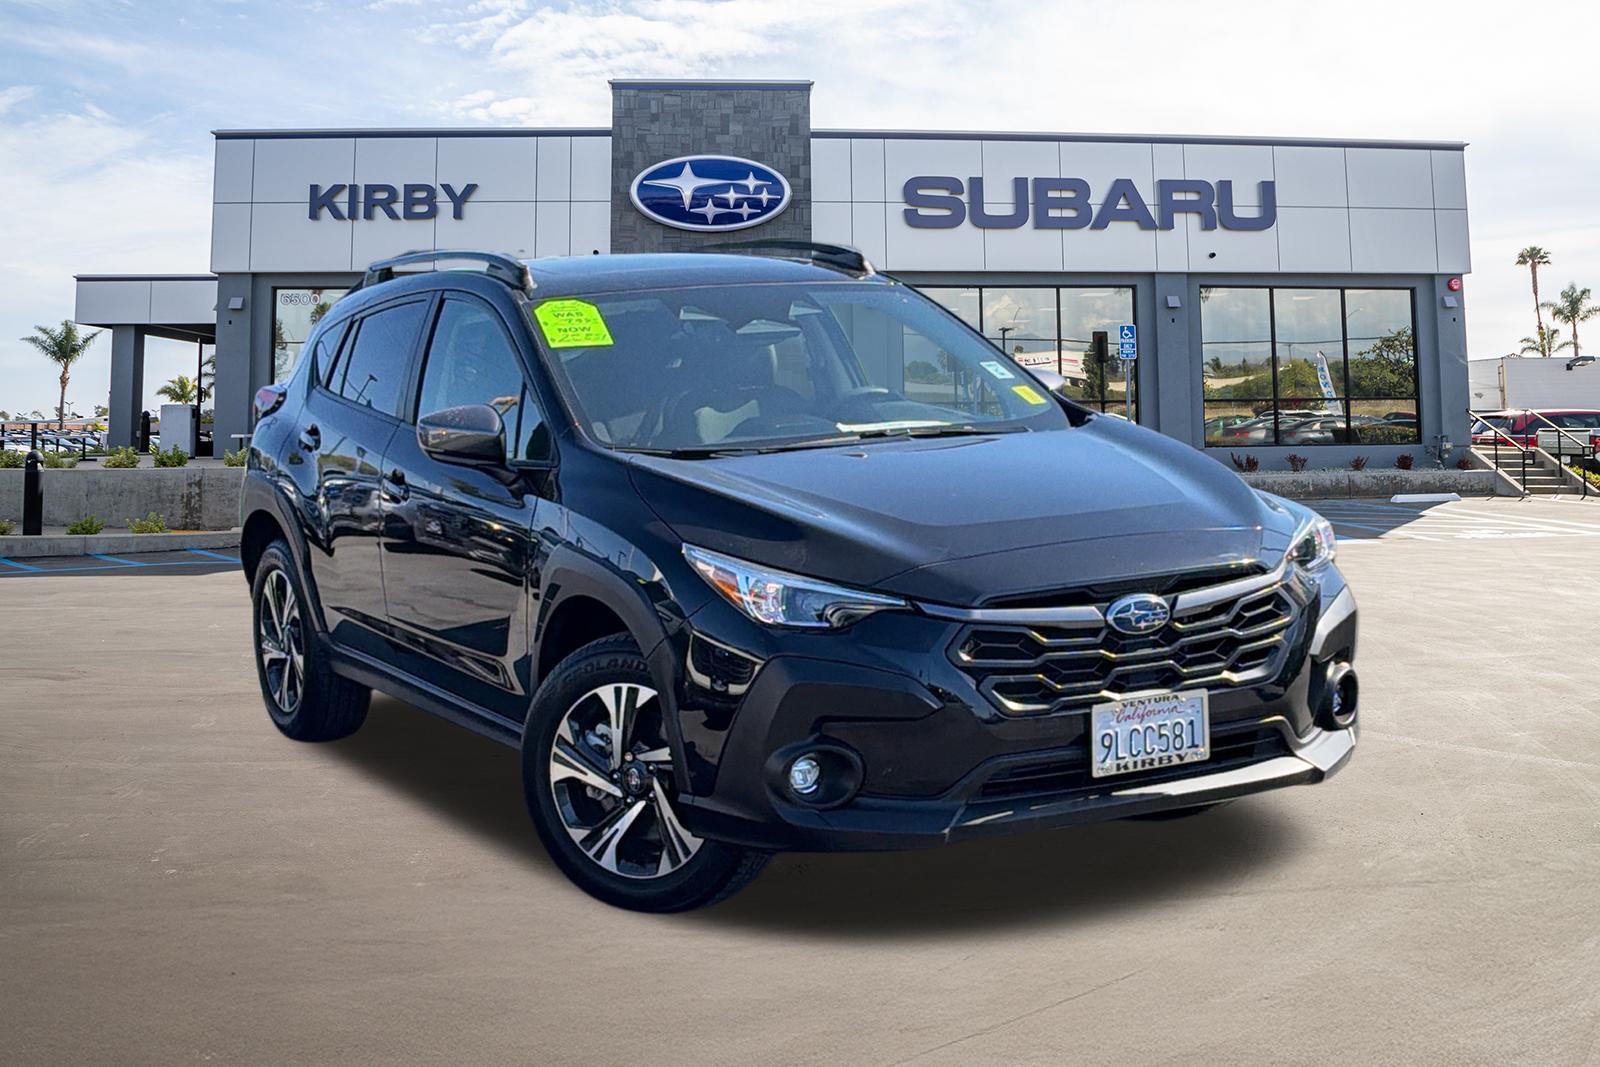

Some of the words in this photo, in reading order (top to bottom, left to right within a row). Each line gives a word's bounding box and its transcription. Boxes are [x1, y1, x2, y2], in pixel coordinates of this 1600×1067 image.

[308, 183, 479, 221] KIRBY
[903, 175, 1277, 231] SUBARU
[281, 293, 320, 305] 6500
[1121, 694, 1180, 708] VENTURA
[1114, 705, 1185, 724] California
[1101, 719, 1199, 764] 9LCC581
[1115, 752, 1188, 772] KIRBY
